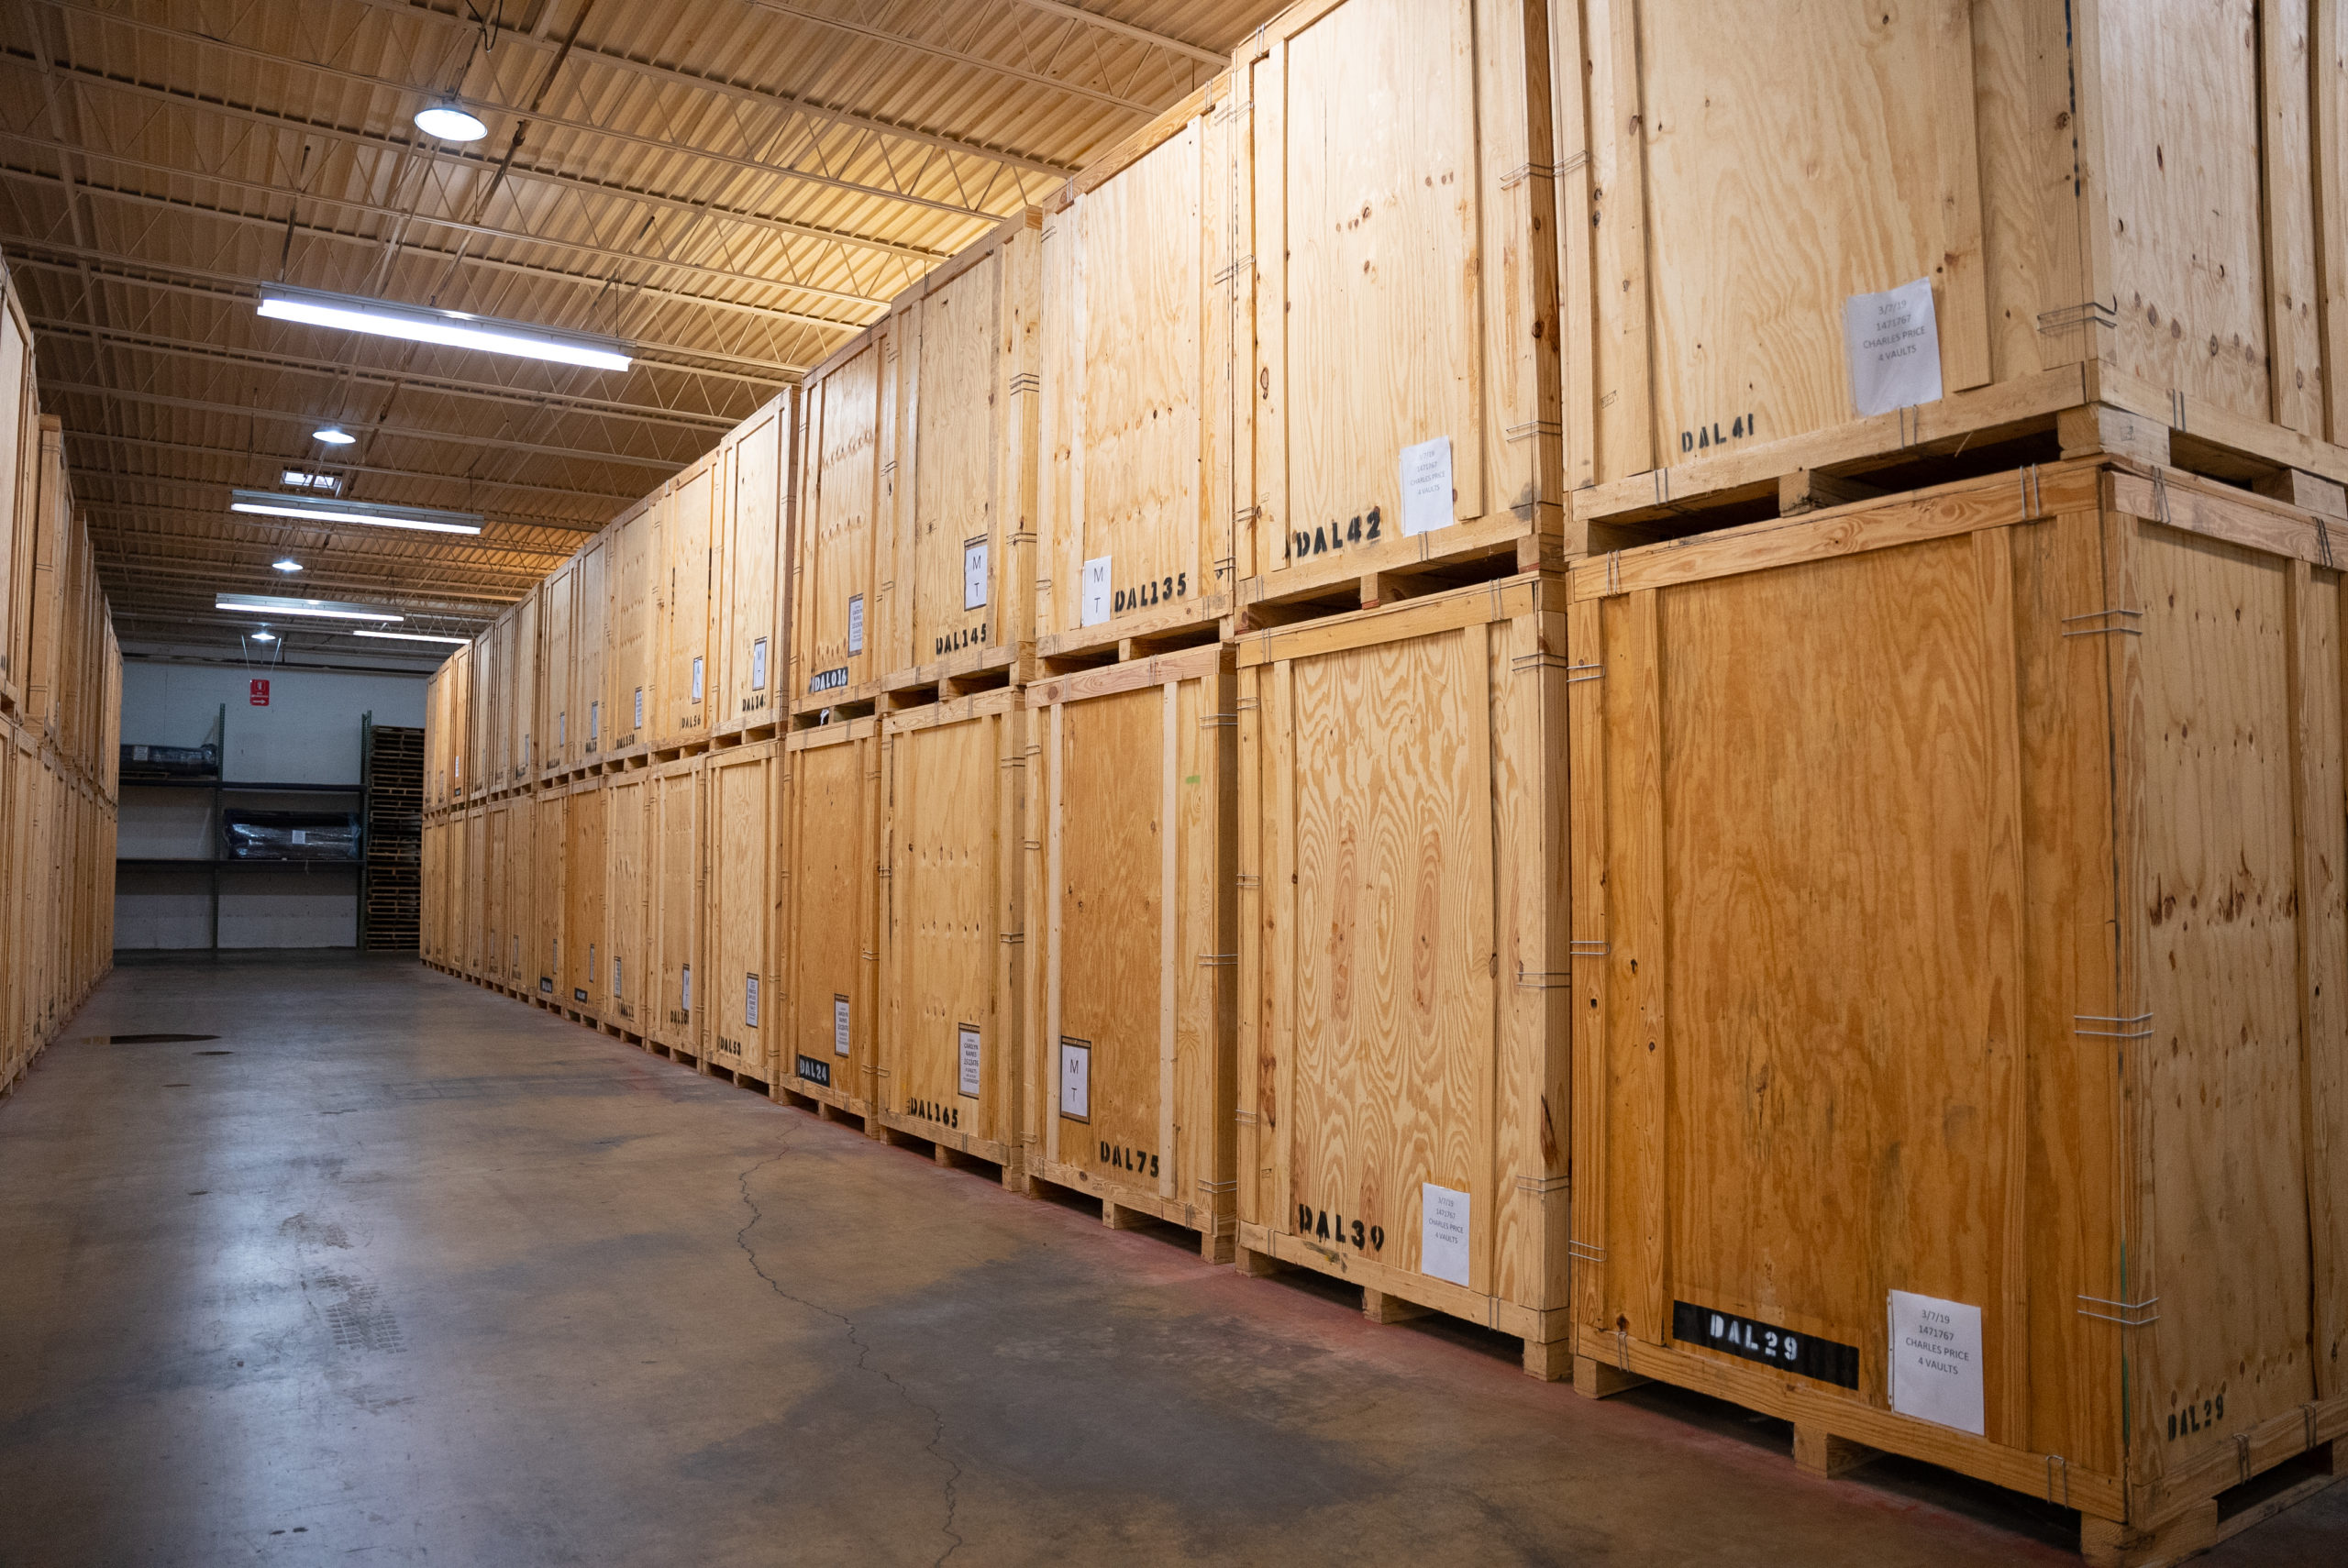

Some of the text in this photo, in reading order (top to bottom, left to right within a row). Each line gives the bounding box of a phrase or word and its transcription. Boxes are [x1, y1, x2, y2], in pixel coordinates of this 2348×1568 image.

[1878, 300, 1907, 315] 3/7/19
[1877, 315, 1911, 331] 1471767
[1863, 326, 1925, 348] CHARLES PRICE
[1885, 345, 1917, 360] VAULTS
[1681, 414, 1754, 453] DAL41
[1410, 470, 1445, 486] CHARLES PRICE
[1422, 484, 1440, 494] VAULTS
[1296, 509, 1380, 558] DAL42
[972, 555, 981, 570] M
[1093, 566, 1103, 584] M
[974, 582, 980, 597] T
[1114, 572, 1186, 613] DAL135
[1094, 597, 1101, 613] T
[936, 623, 987, 655] DAL145
[799, 1059, 827, 1082] DAL24
[1069, 1059, 1079, 1074] M
[1071, 1088, 1078, 1102] T
[910, 1097, 958, 1128] DAL165
[1100, 1141, 1159, 1177] DAL75
[1428, 1218, 1464, 1233] CHARLES PRICE
[1439, 1232, 1457, 1243] VAULTS
[1922, 1309, 1950, 1324] 3/7/19
[1710, 1314, 1798, 1361] DAL29
[1919, 1325, 1955, 1341] 1471767
[1906, 1337, 1969, 1362] CHARLES PRICE
[1925, 1359, 1958, 1375] VAULTS
[2168, 1394, 2224, 1442] DAL29
